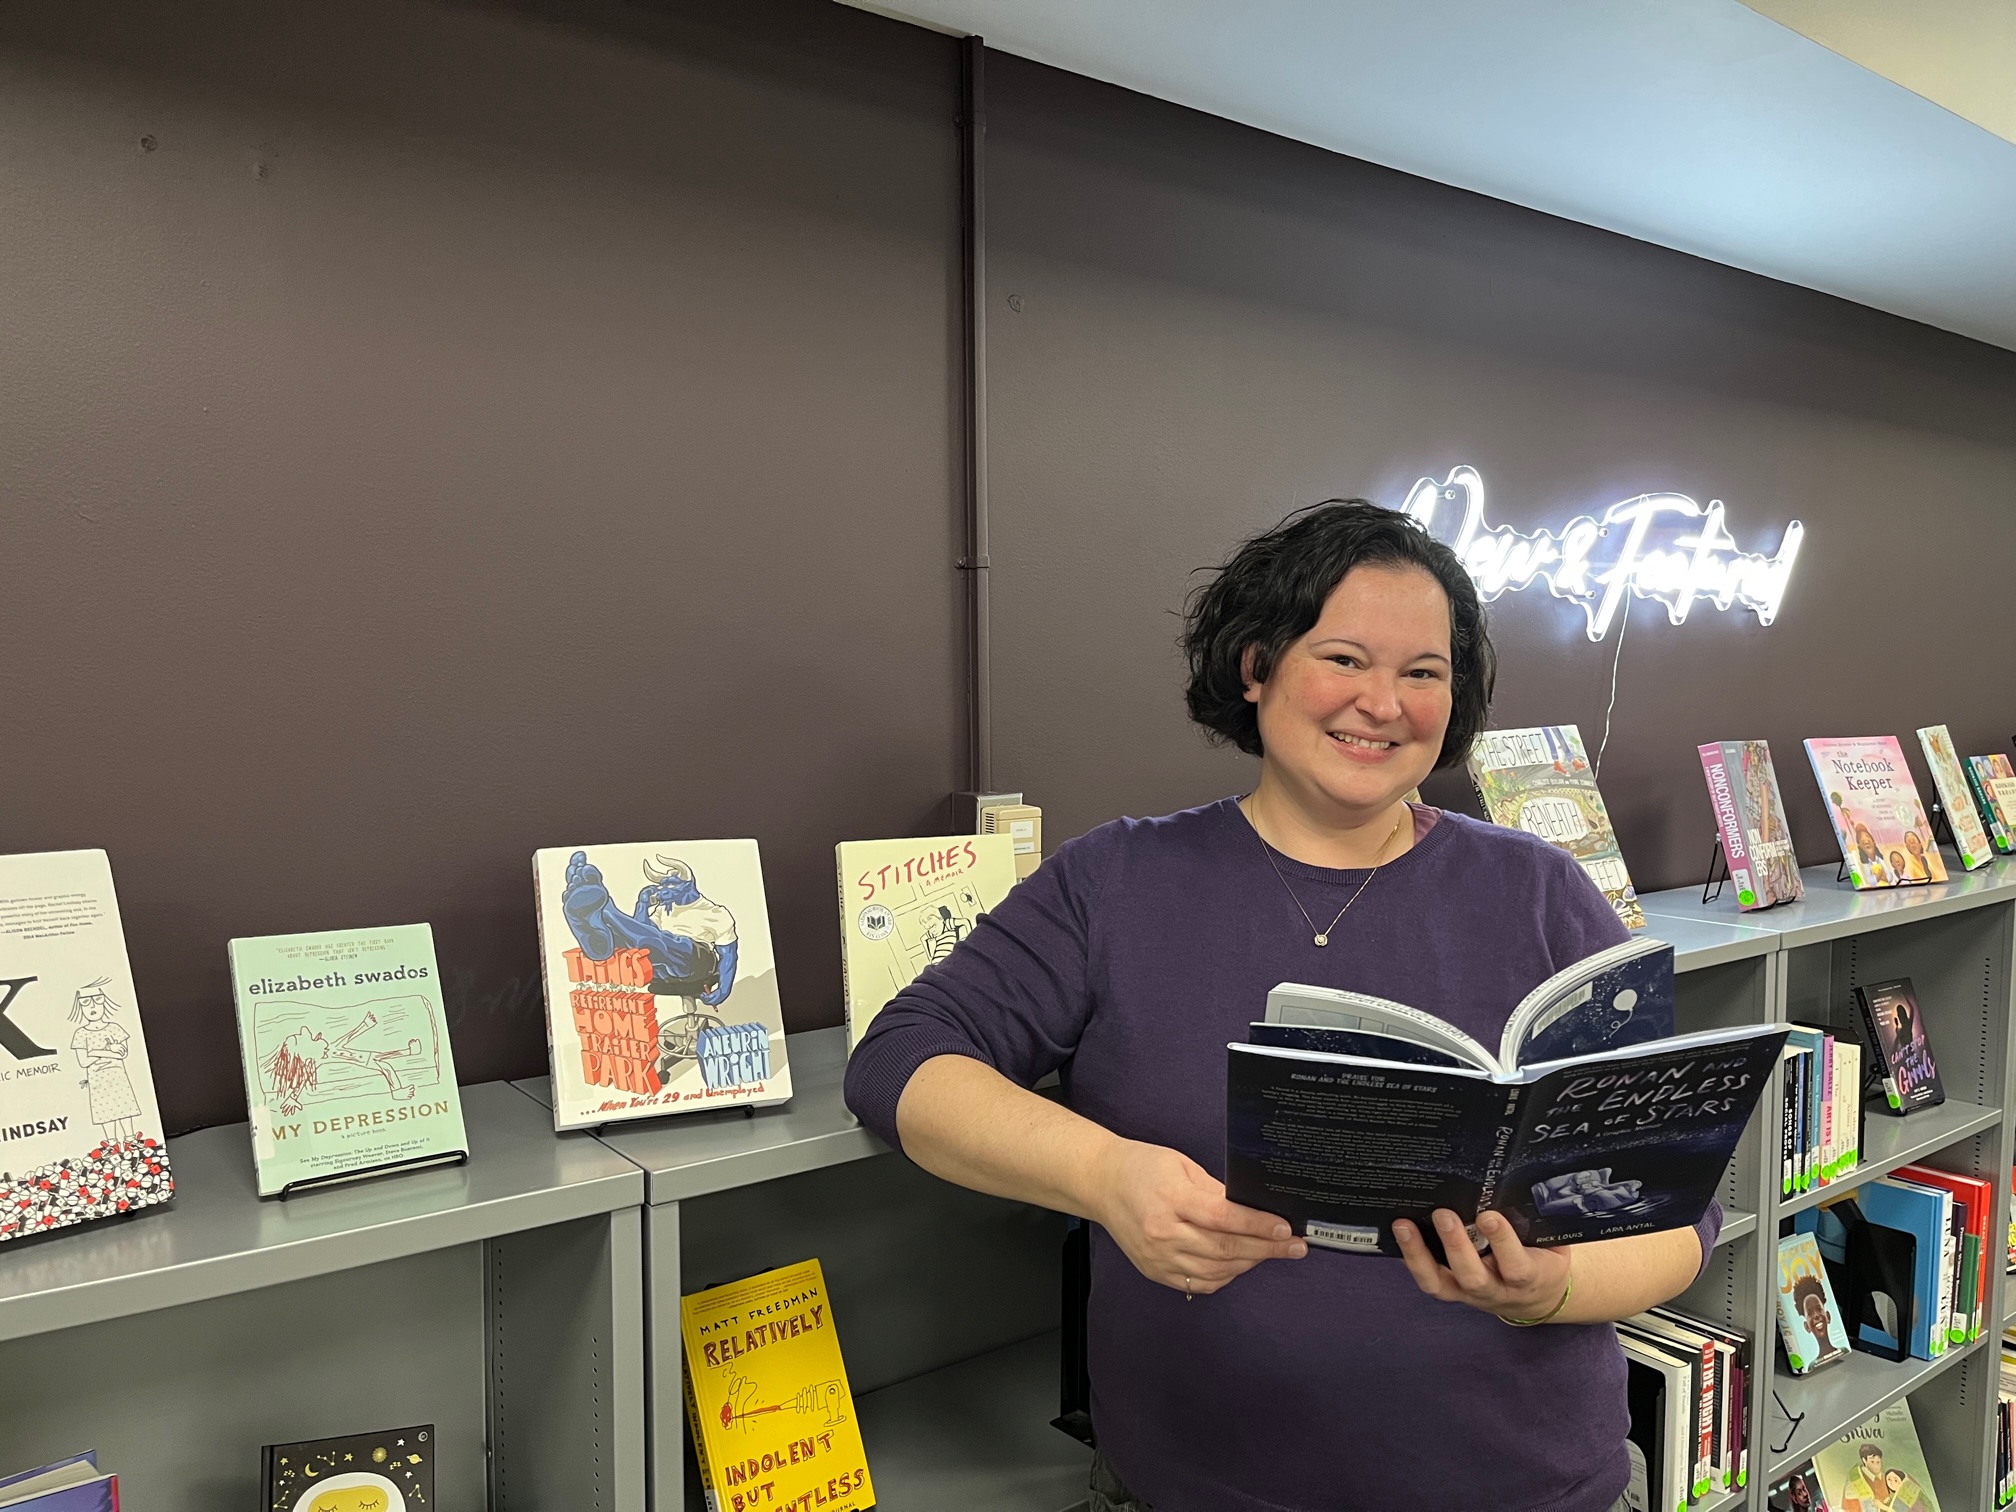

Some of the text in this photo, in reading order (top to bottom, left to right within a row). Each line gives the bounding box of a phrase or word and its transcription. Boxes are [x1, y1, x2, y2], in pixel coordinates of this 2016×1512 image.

[1502, 733, 1549, 766] STREET
[1831, 758, 1895, 774] Notebook
[1845, 776, 1893, 795] Keeper
[1523, 803, 1585, 838] BENEATH
[1710, 763, 1745, 859] NONCONFORMERS
[858, 841, 977, 900] STITCHES
[925, 868, 964, 887] A MEMOIR
[249, 965, 429, 995] elizabeth swados
[572, 1006, 655, 1043] HOME
[1905, 1053, 1919, 1068] THE
[1909, 1034, 1925, 1053] STOP
[0, 1063, 61, 1082] IC MEMOIR
[581, 1050, 660, 1097] PARK
[1557, 1061, 1696, 1102] RONAN
[1702, 1057, 1747, 1073] AND
[630, 1095, 659, 1108] You're
[662, 1092, 680, 1104] 29
[683, 1089, 704, 1101] and
[706, 1082, 765, 1099] Unemployed
[1546, 1073, 1751, 1118] THE ENDLESS
[0, 1116, 69, 1143] INDSAY
[271, 1124, 302, 1141] MY
[313, 1101, 449, 1134] DEPRESSION
[1529, 1122, 1590, 1143] SEA
[1636, 1097, 1737, 1125] STARS
[1536, 1231, 1584, 1243] RICK LOUIS
[1600, 1221, 1656, 1235] LARA ANTAL
[1780, 1249, 1824, 1294] JOY
[700, 1316, 738, 1336] MATT
[749, 1287, 818, 1320] FREEDMAN
[703, 1304, 824, 1369] RELATIVELY
[1702, 1361, 1715, 1434] THE RIGHT
[725, 1429, 834, 1487] INDOLENT
[731, 1481, 775, 1512] BUT
